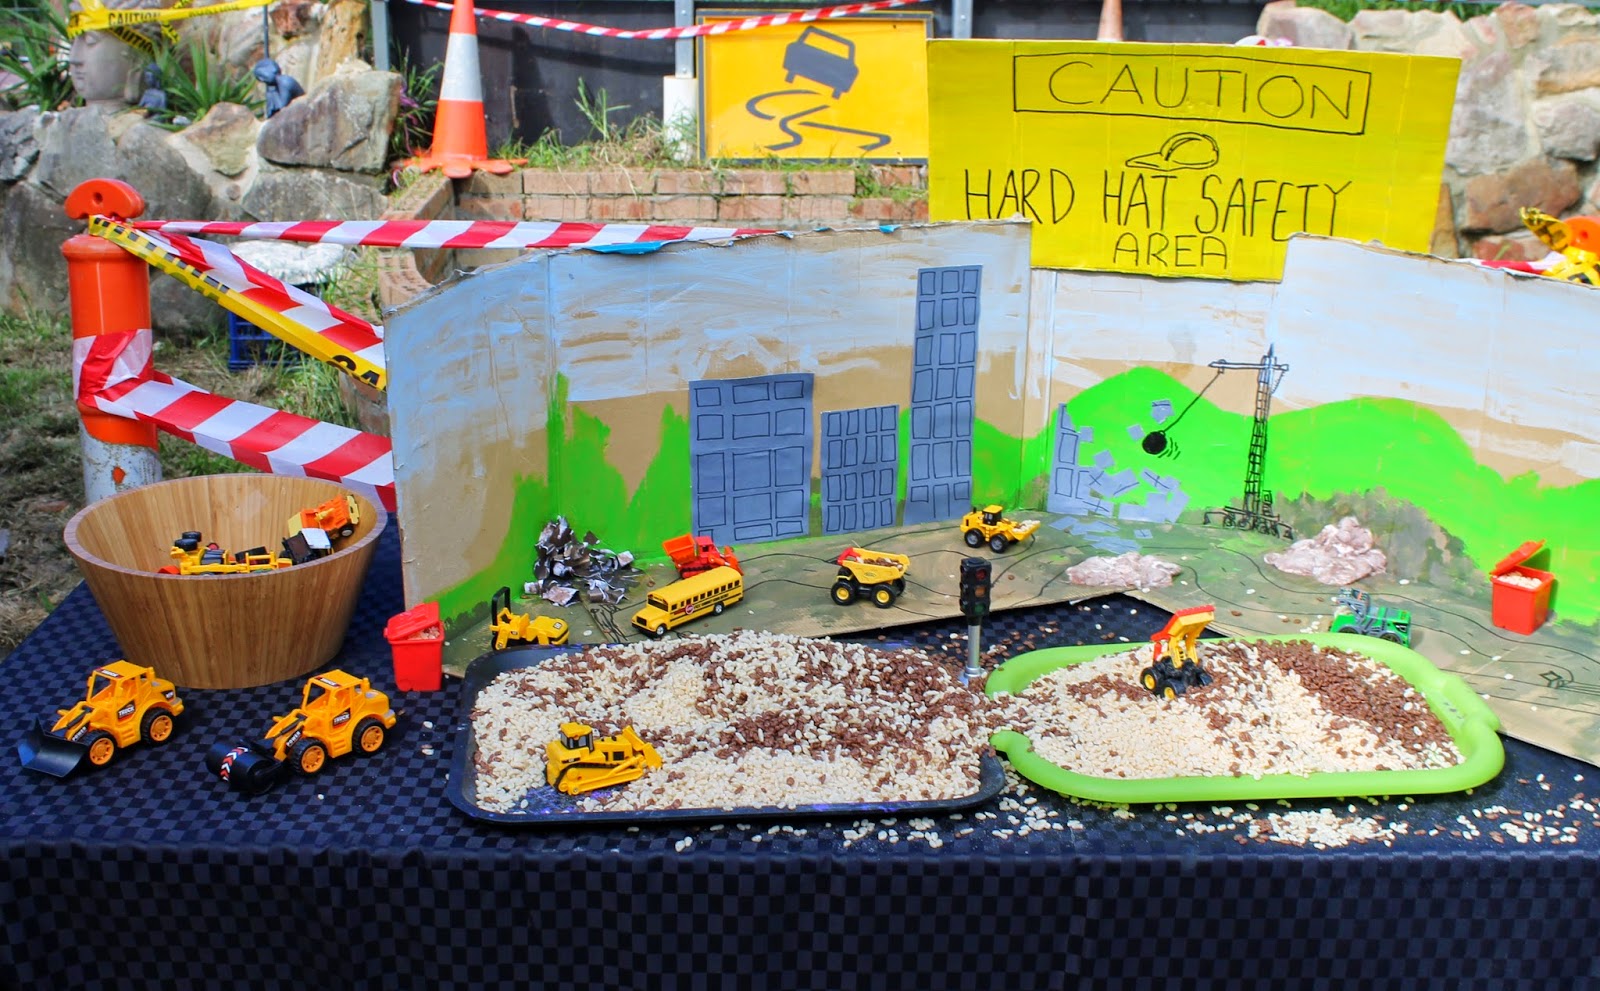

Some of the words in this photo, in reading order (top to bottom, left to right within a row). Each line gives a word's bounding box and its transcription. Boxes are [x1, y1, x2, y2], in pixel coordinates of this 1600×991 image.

[1049, 61, 1352, 120] CAUTION
[965, 169, 1075, 224] HARD
[1104, 170, 1178, 231] HAT
[1195, 174, 1353, 242] SAFETY
[1113, 233, 1228, 270] AREA
[118, 704, 136, 718] TRUCK
[333, 712, 350, 725] TRUCK
[286, 730, 302, 748] POWER
